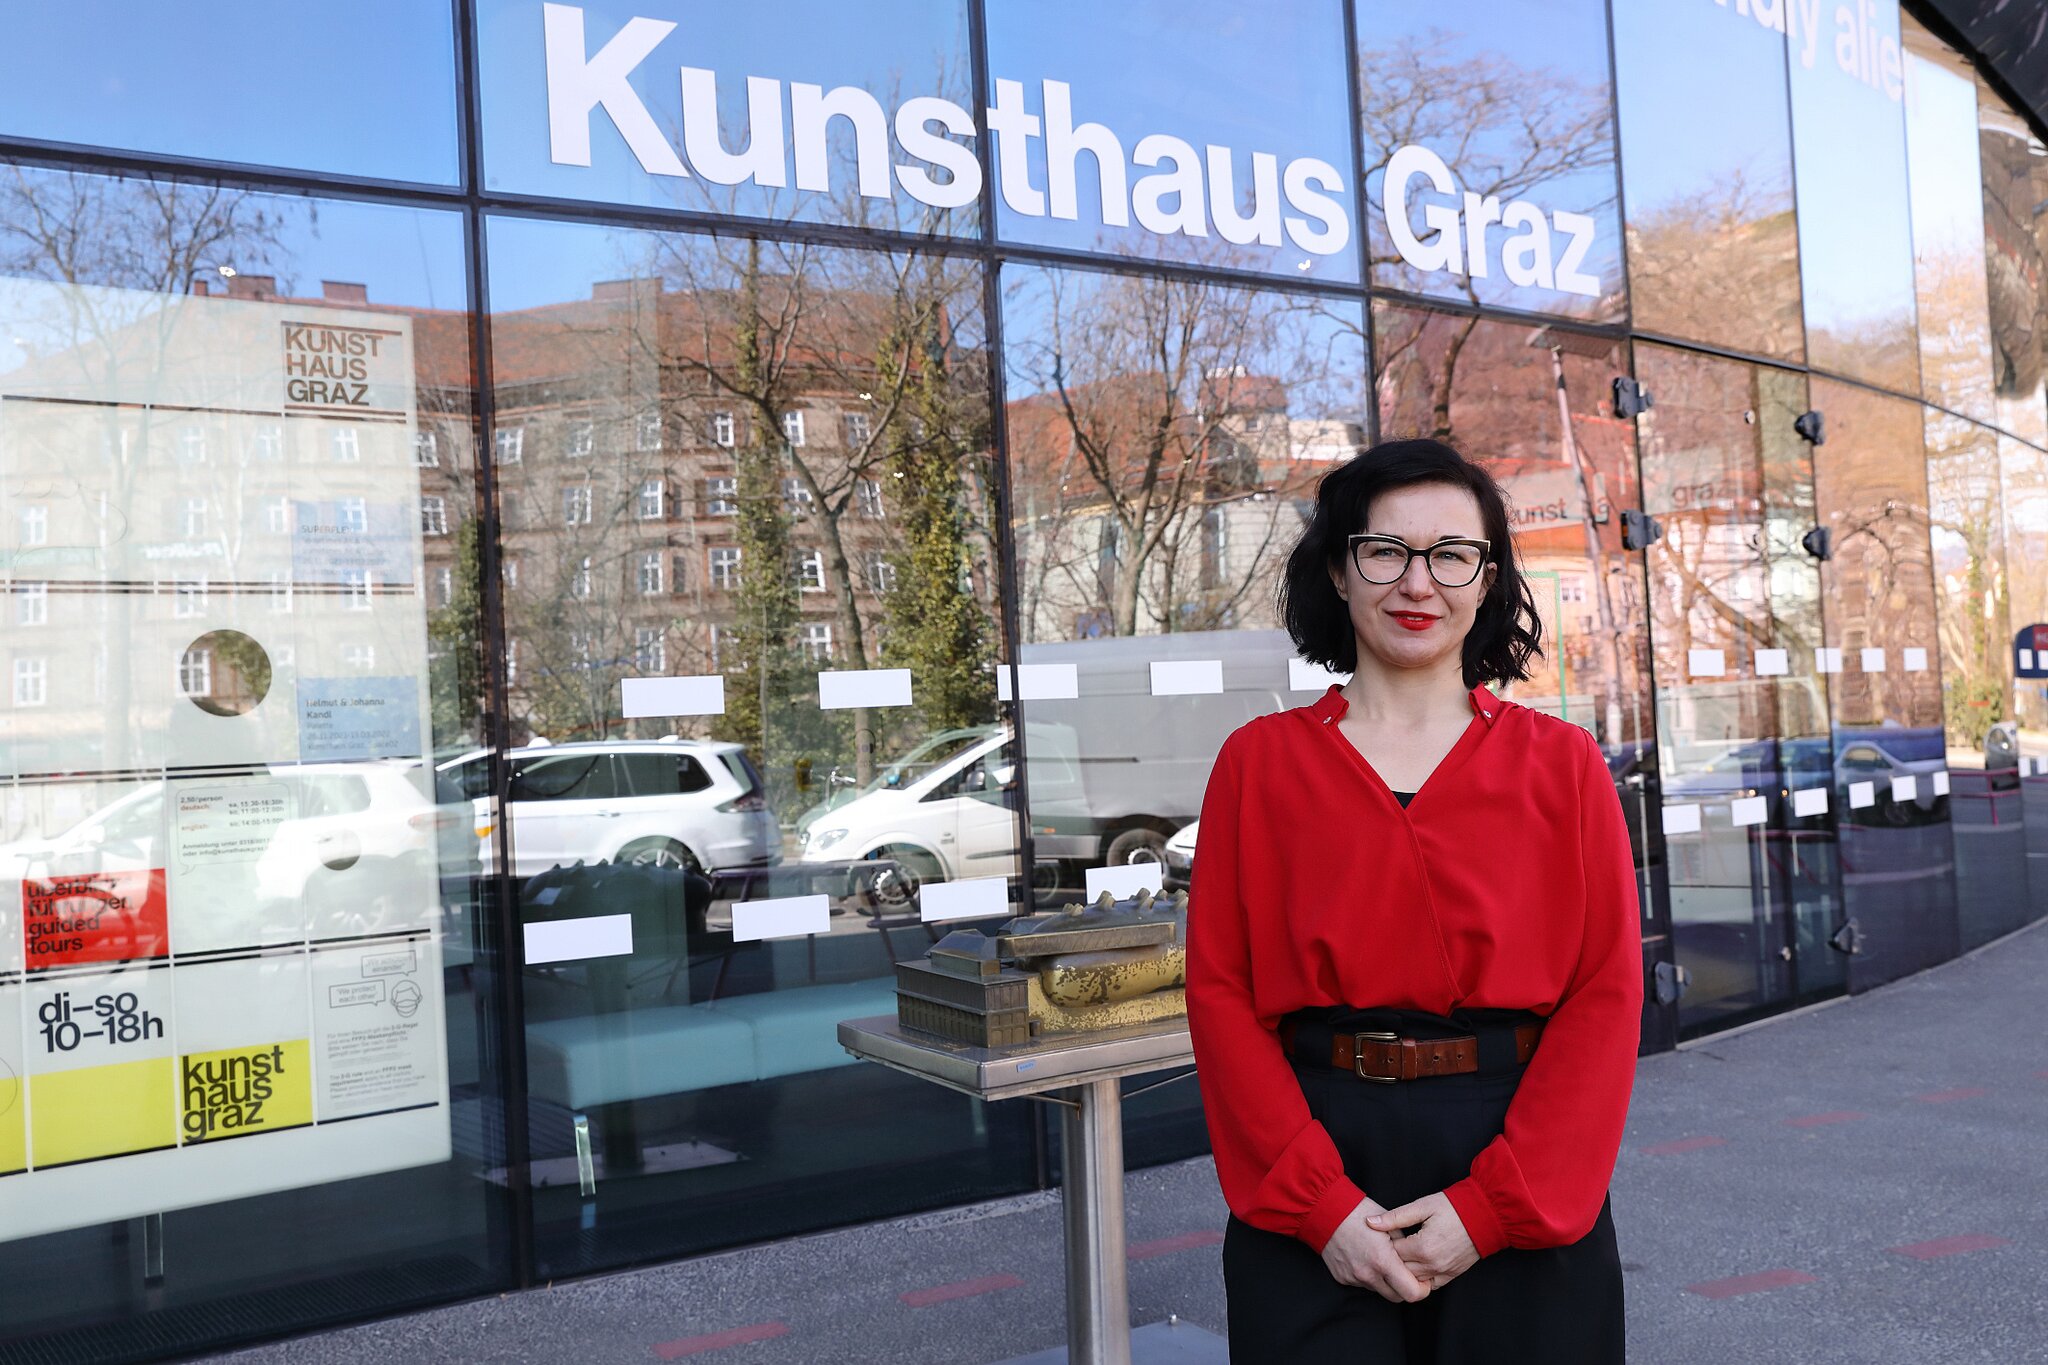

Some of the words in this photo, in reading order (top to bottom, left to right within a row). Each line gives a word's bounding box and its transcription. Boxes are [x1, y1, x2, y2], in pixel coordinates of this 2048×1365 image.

[543, 2, 1350, 255] Kunsthaus
[1382, 144, 1601, 298] Graz
[285, 327, 383, 357] KUNST
[286, 352, 368, 381] HAUS
[287, 379, 369, 406] GRAZ
[306, 699, 338, 708] Helmut
[340, 698, 347, 707] &
[350, 697, 385, 707] Johanna
[306, 710, 332, 719] Kandl
[29, 916, 100, 938] guided
[30, 936, 83, 955] tours
[182, 1045, 285, 1085] kunst
[183, 1075, 273, 1111] haus
[183, 1101, 264, 1142] graz
